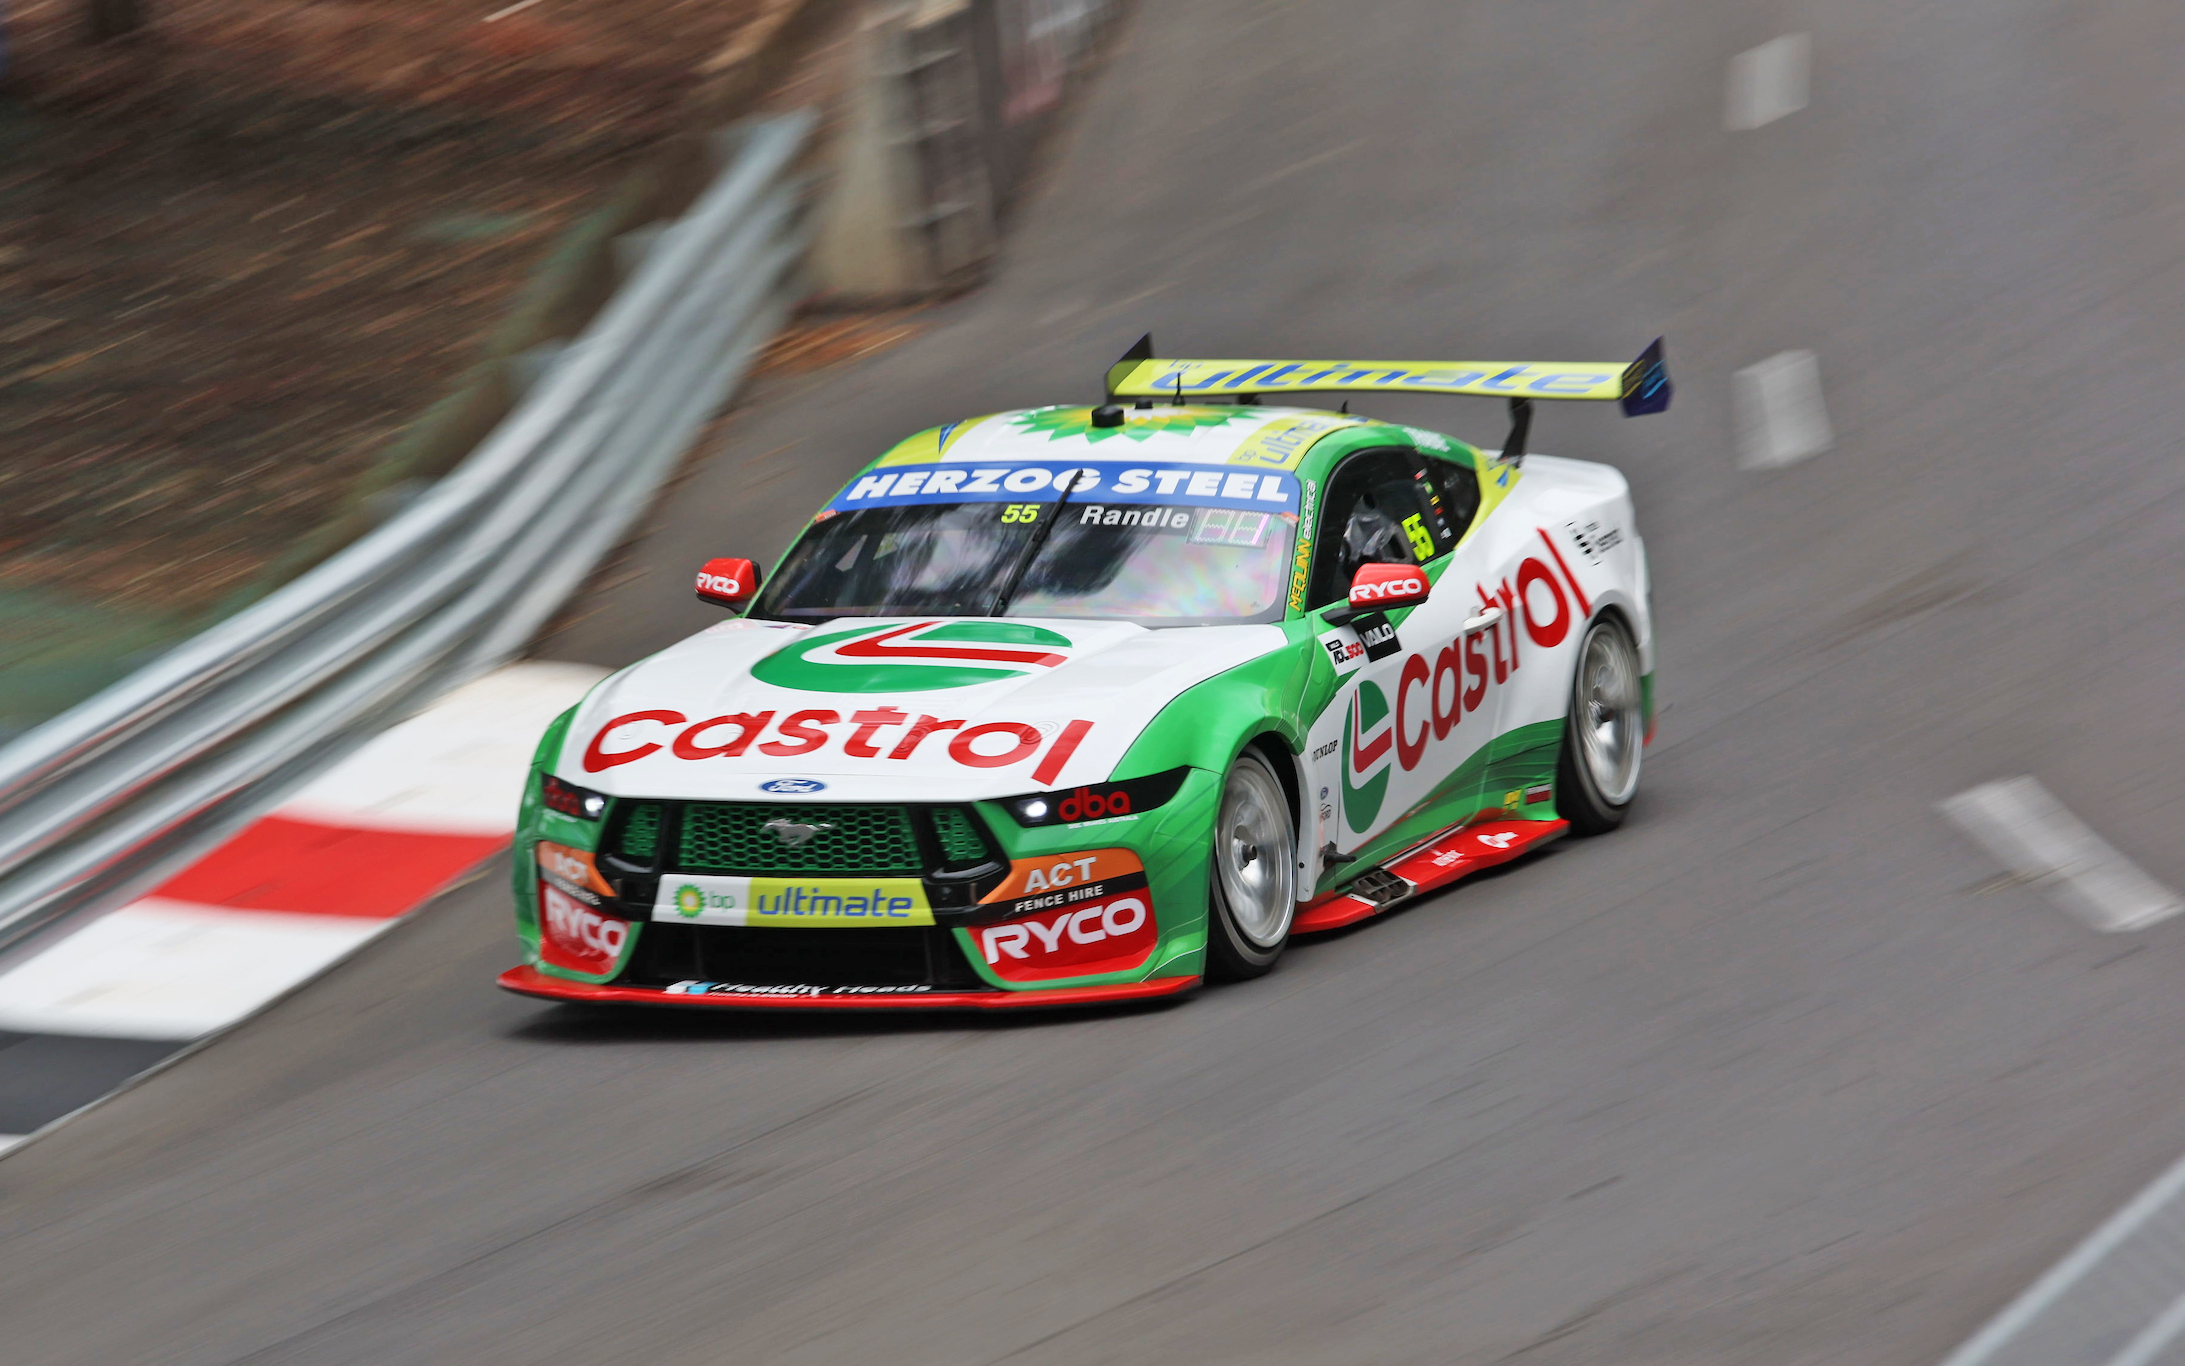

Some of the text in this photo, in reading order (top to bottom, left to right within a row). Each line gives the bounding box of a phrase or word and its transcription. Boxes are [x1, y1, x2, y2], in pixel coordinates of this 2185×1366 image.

[1151, 363, 1611, 393] ultimate
[846, 468, 1289, 502] HERZOG STEEL
[1001, 504, 1041, 525] 55
[1080, 505, 1190, 529] Randle
[1401, 512, 1435, 562] 55
[696, 572, 740, 594] RYCO
[1349, 578, 1422, 601] RYCO
[769, 779, 818, 794] Ford
[1059, 787, 1131, 821] dba
[1023, 857, 1097, 894] ACT
[709, 887, 913, 917] bp ultimate
[1015, 885, 1104, 913] FENCE HIRE
[544, 886, 628, 957] RYCO
[982, 898, 1146, 965] RYCO
